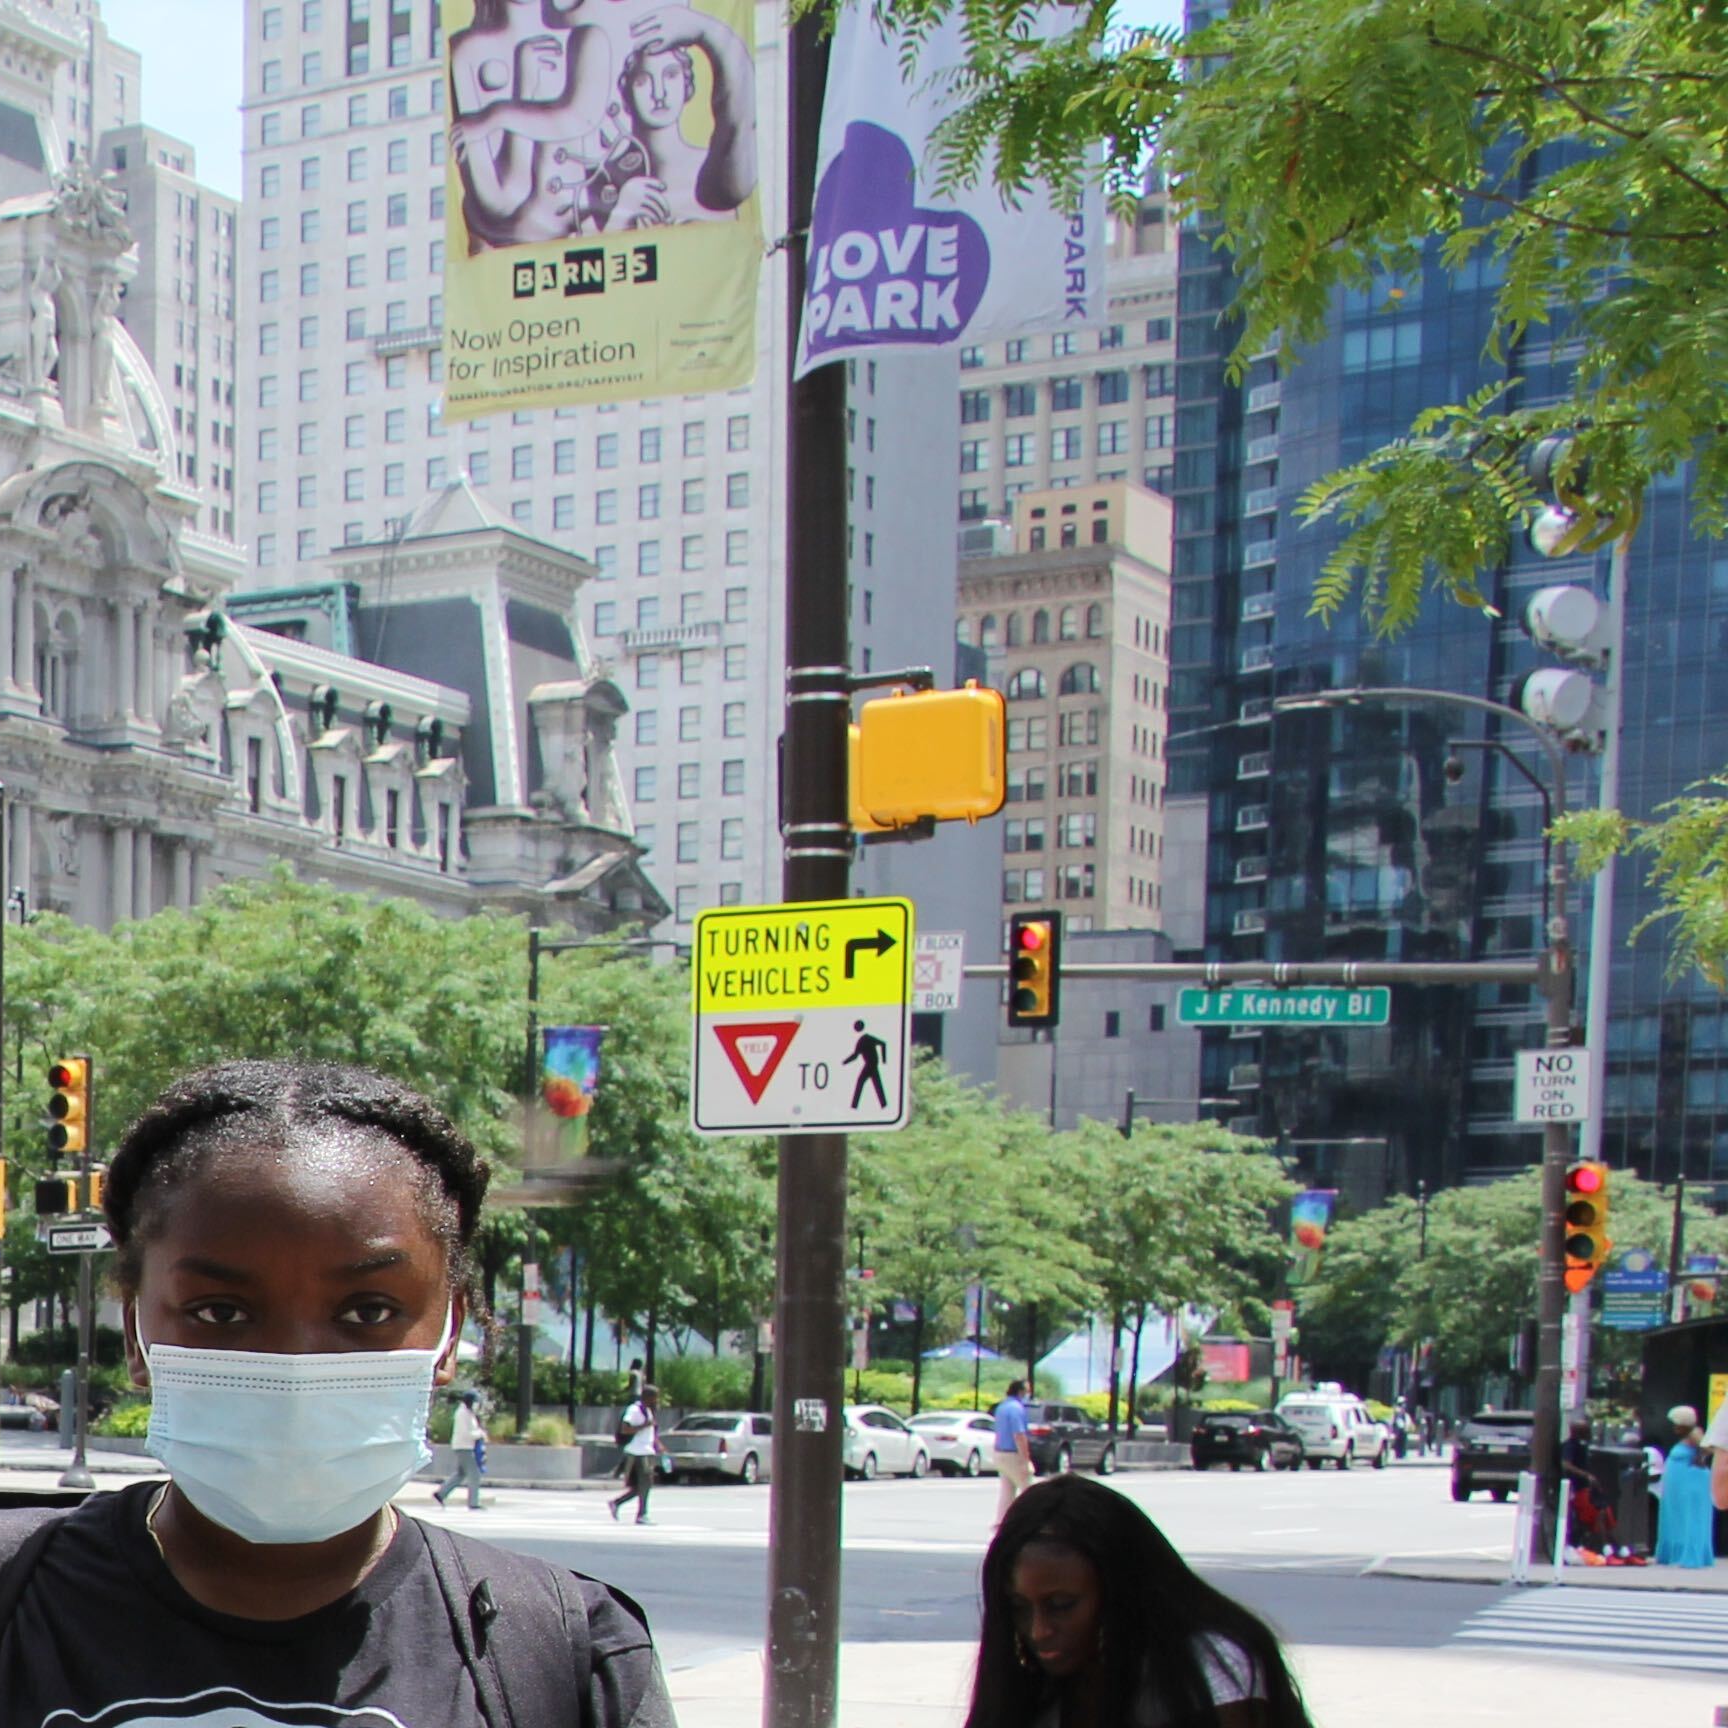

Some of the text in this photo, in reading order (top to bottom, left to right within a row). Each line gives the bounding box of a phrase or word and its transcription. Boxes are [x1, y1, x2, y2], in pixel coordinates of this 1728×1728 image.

[514, 246, 654, 298] BARNES
[812, 224, 959, 294] LOVE
[1064, 213, 1087, 320] PARK
[808, 277, 961, 345] PARK
[450, 317, 580, 351] Now Open
[449, 357, 486, 380] for
[493, 341, 636, 379] Inspiration
[707, 924, 830, 957] TURNING
[706, 966, 830, 998] VEHICLES
[925, 993, 955, 1009] BOX
[1195, 994, 1209, 1015] J
[1218, 994, 1232, 1015] F
[1242, 993, 1337, 1020] Kennedy
[798, 1062, 829, 1091] TO
[1535, 1055, 1573, 1072] NO
[1532, 1074, 1576, 1087] TURN
[1540, 1089, 1564, 1102] ON
[1533, 1103, 1574, 1118] RED
